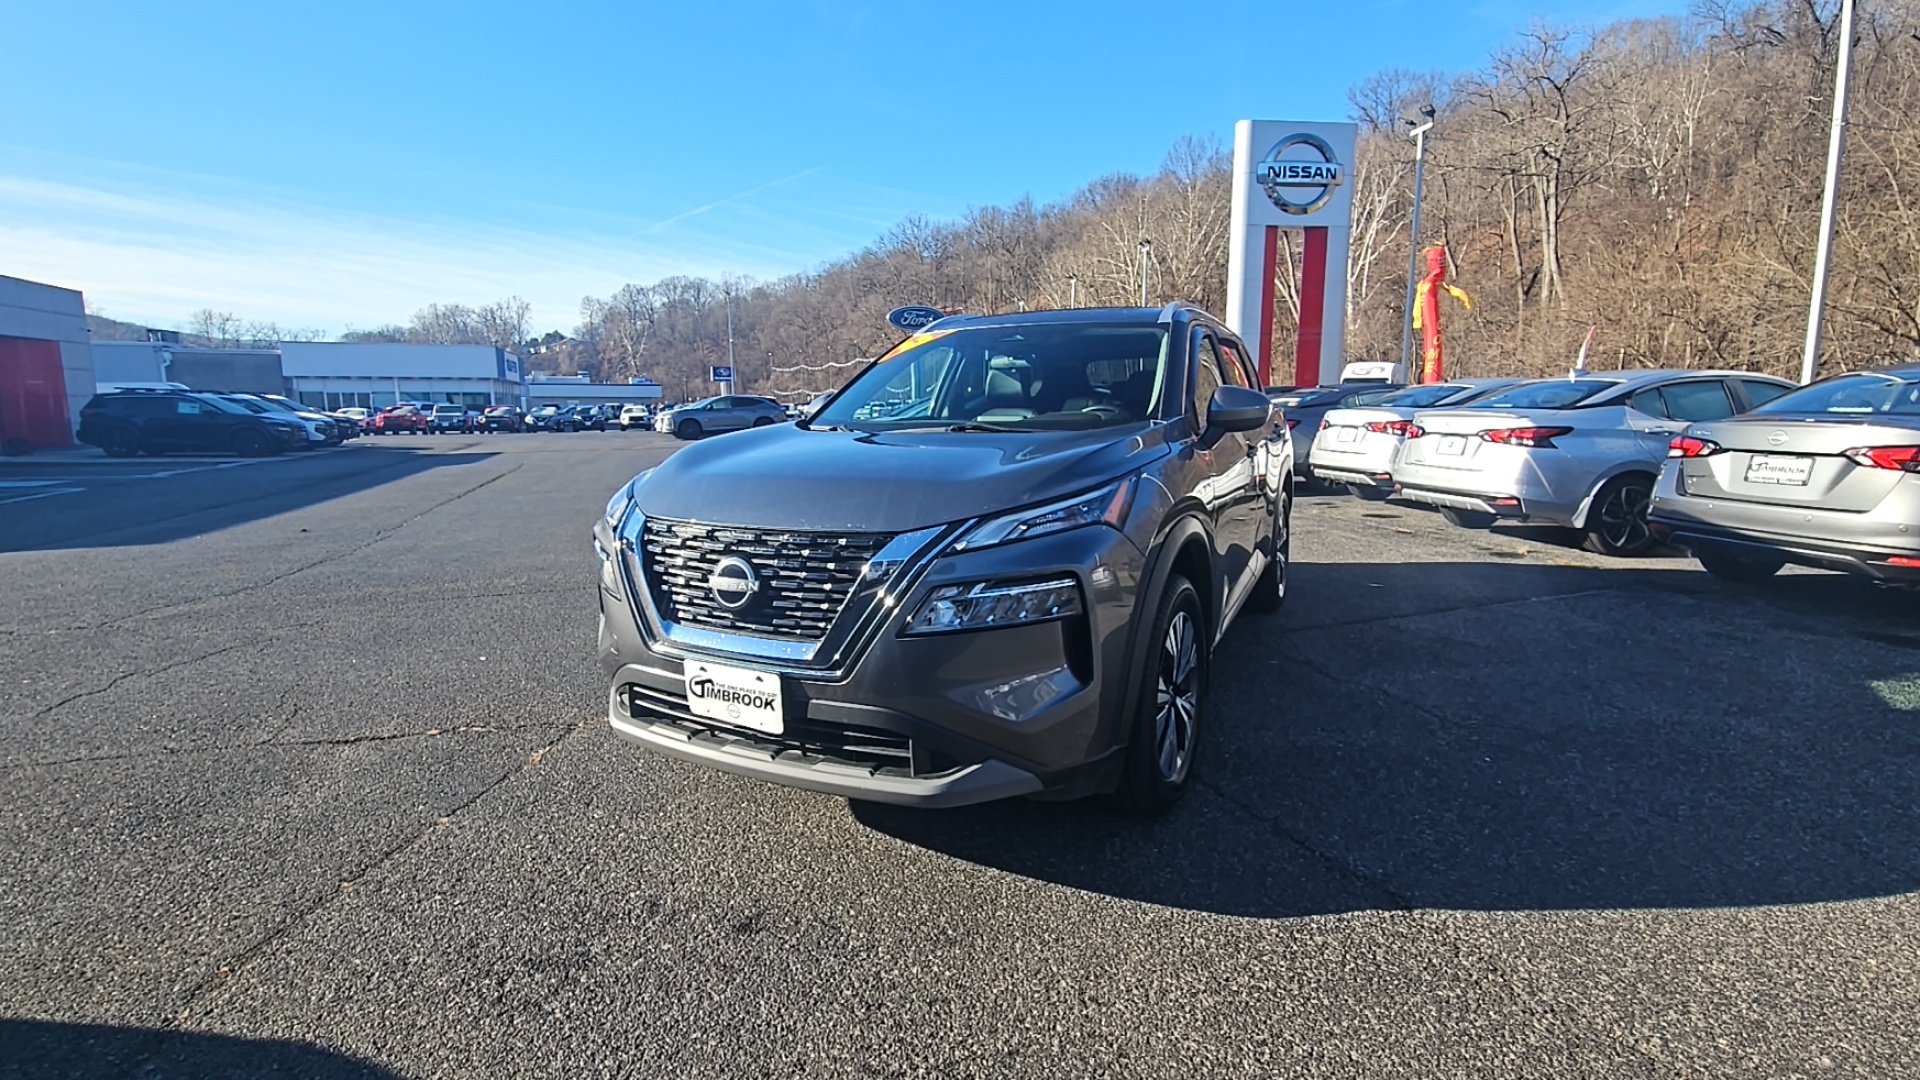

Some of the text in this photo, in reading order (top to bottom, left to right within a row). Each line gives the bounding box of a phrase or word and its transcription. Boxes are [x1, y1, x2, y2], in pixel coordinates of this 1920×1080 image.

[1267, 165, 1337, 180] NISSAN
[901, 310, 935, 325] Ford
[710, 577, 760, 593] NISSAN
[689, 675, 776, 712] TIMBROOK
